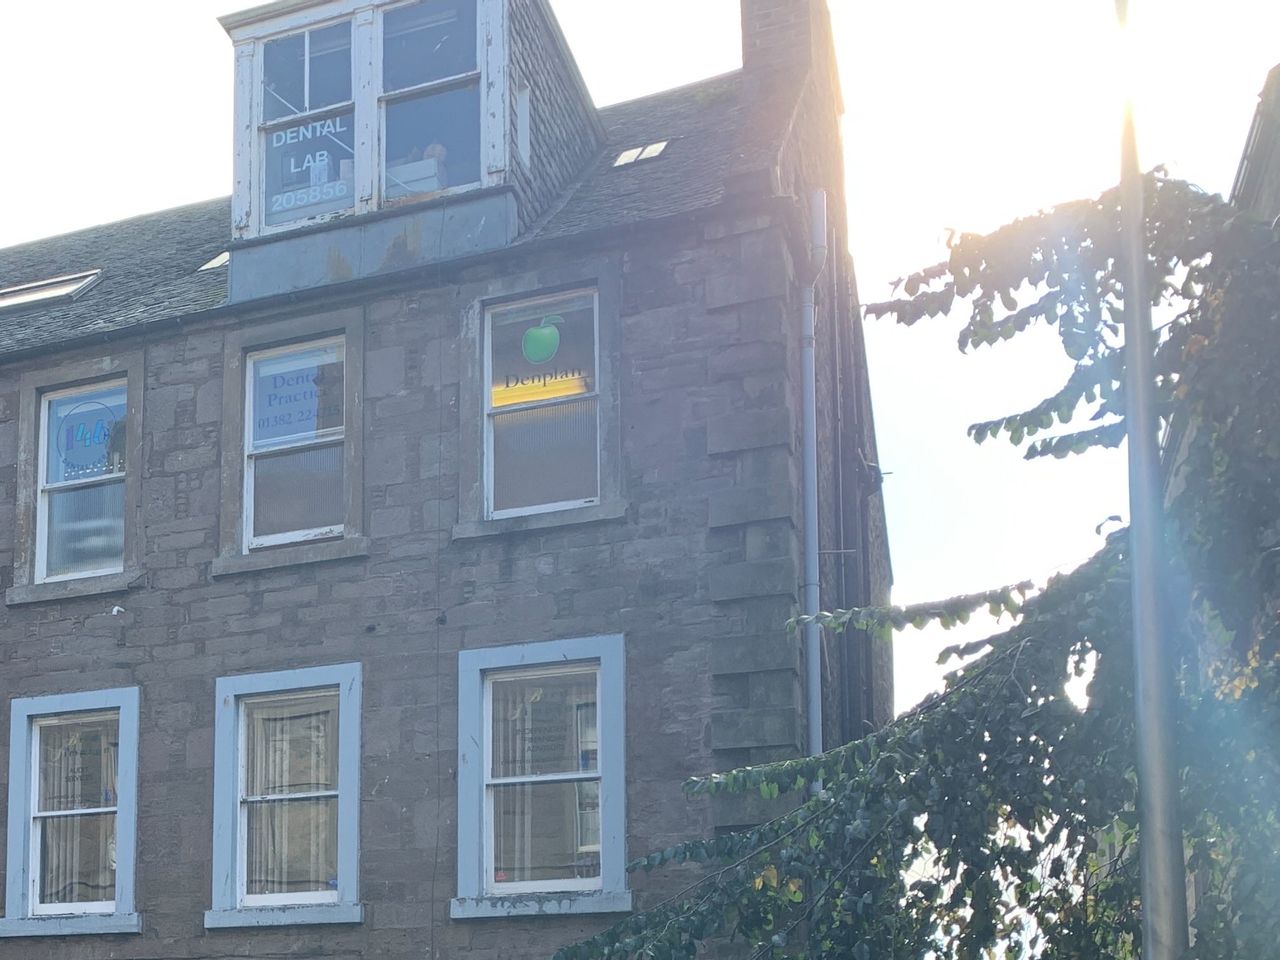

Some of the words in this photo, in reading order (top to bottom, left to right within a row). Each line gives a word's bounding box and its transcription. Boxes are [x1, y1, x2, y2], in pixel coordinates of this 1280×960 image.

[272, 117, 348, 148] DENTAL
[290, 151, 329, 173] LAB
[271, 181, 348, 212] 205856
[504, 367, 583, 389] Denplan
[258, 412, 292, 429] 01382
[66, 419, 110, 451] 146
